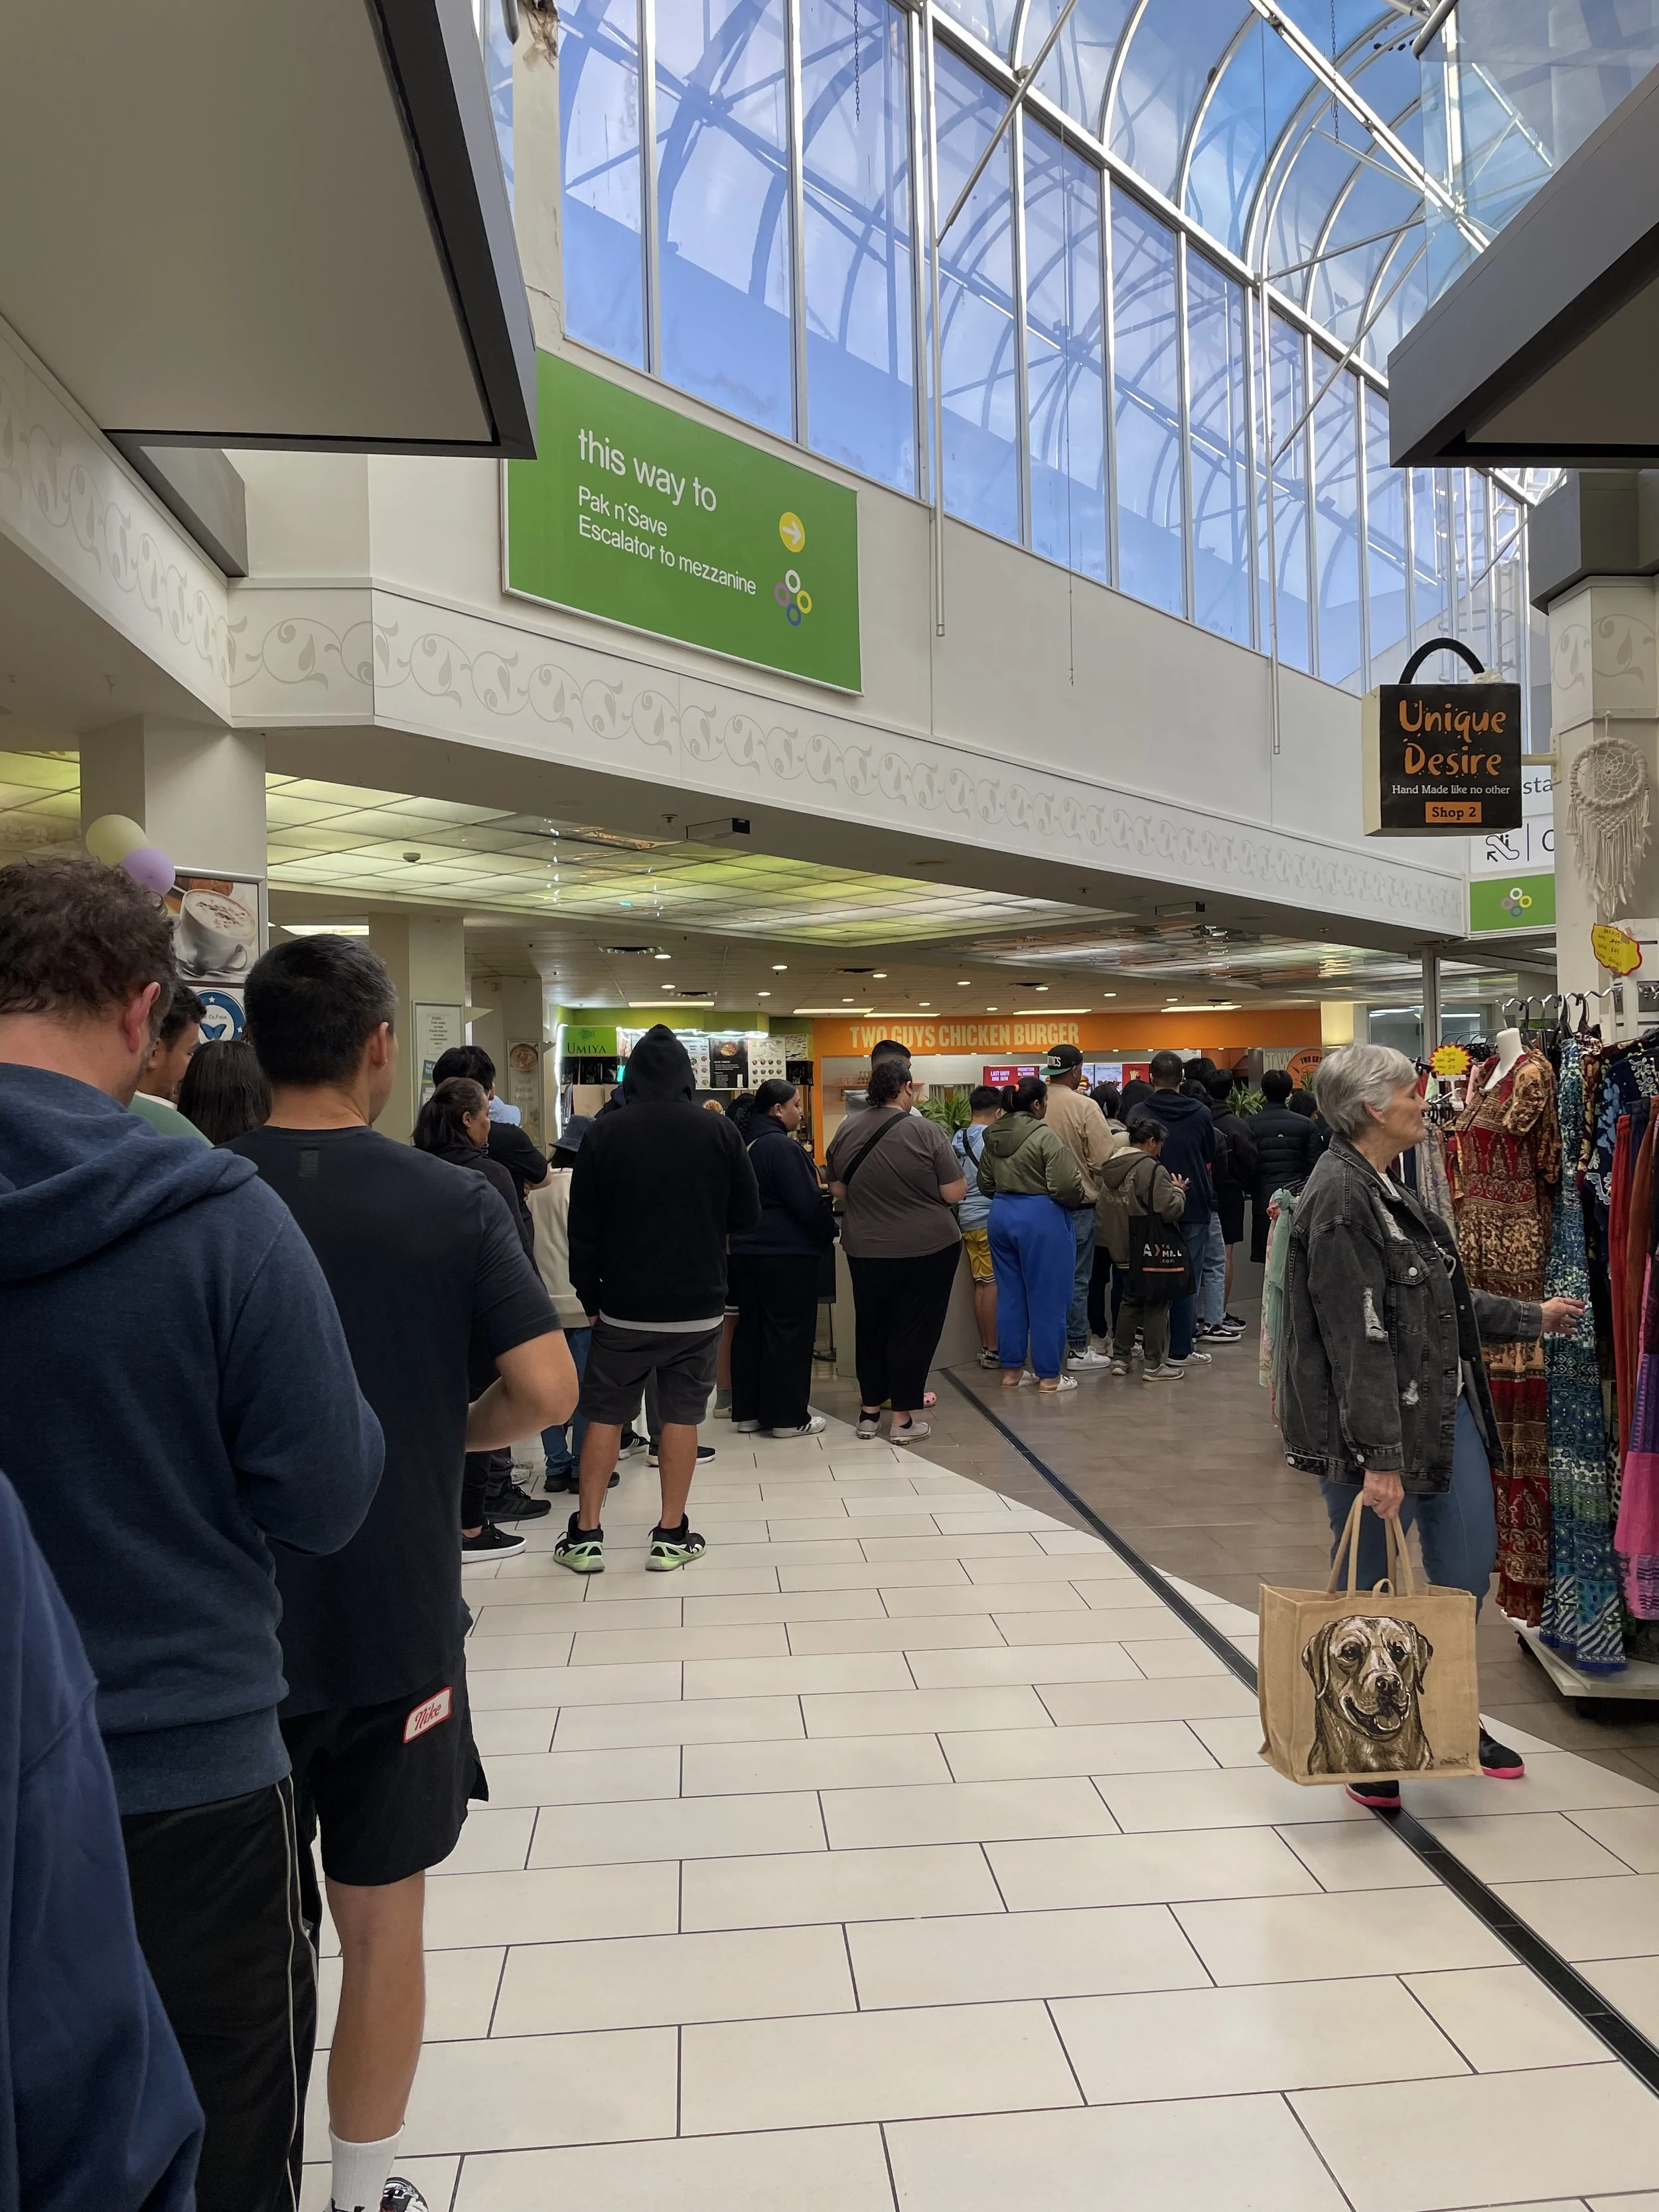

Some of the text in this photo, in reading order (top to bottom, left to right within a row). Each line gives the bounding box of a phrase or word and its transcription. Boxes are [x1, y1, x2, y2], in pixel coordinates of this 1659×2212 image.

[578, 429, 717, 512] this way to
[579, 485, 611, 516] Pak
[579, 514, 756, 595] Escalator to mezzanine
[1400, 700, 1506, 743] Unique
[1405, 743, 1502, 776] Desire
[1392, 785, 1419, 794] Hand
[1421, 785, 1449, 794] Made
[1451, 784, 1468, 794] like
[1485, 785, 1510, 794] other
[1432, 806, 1476, 820] Shop 2
[849, 1023, 1080, 1048] TWO GUYS CHICKEN BURGER
